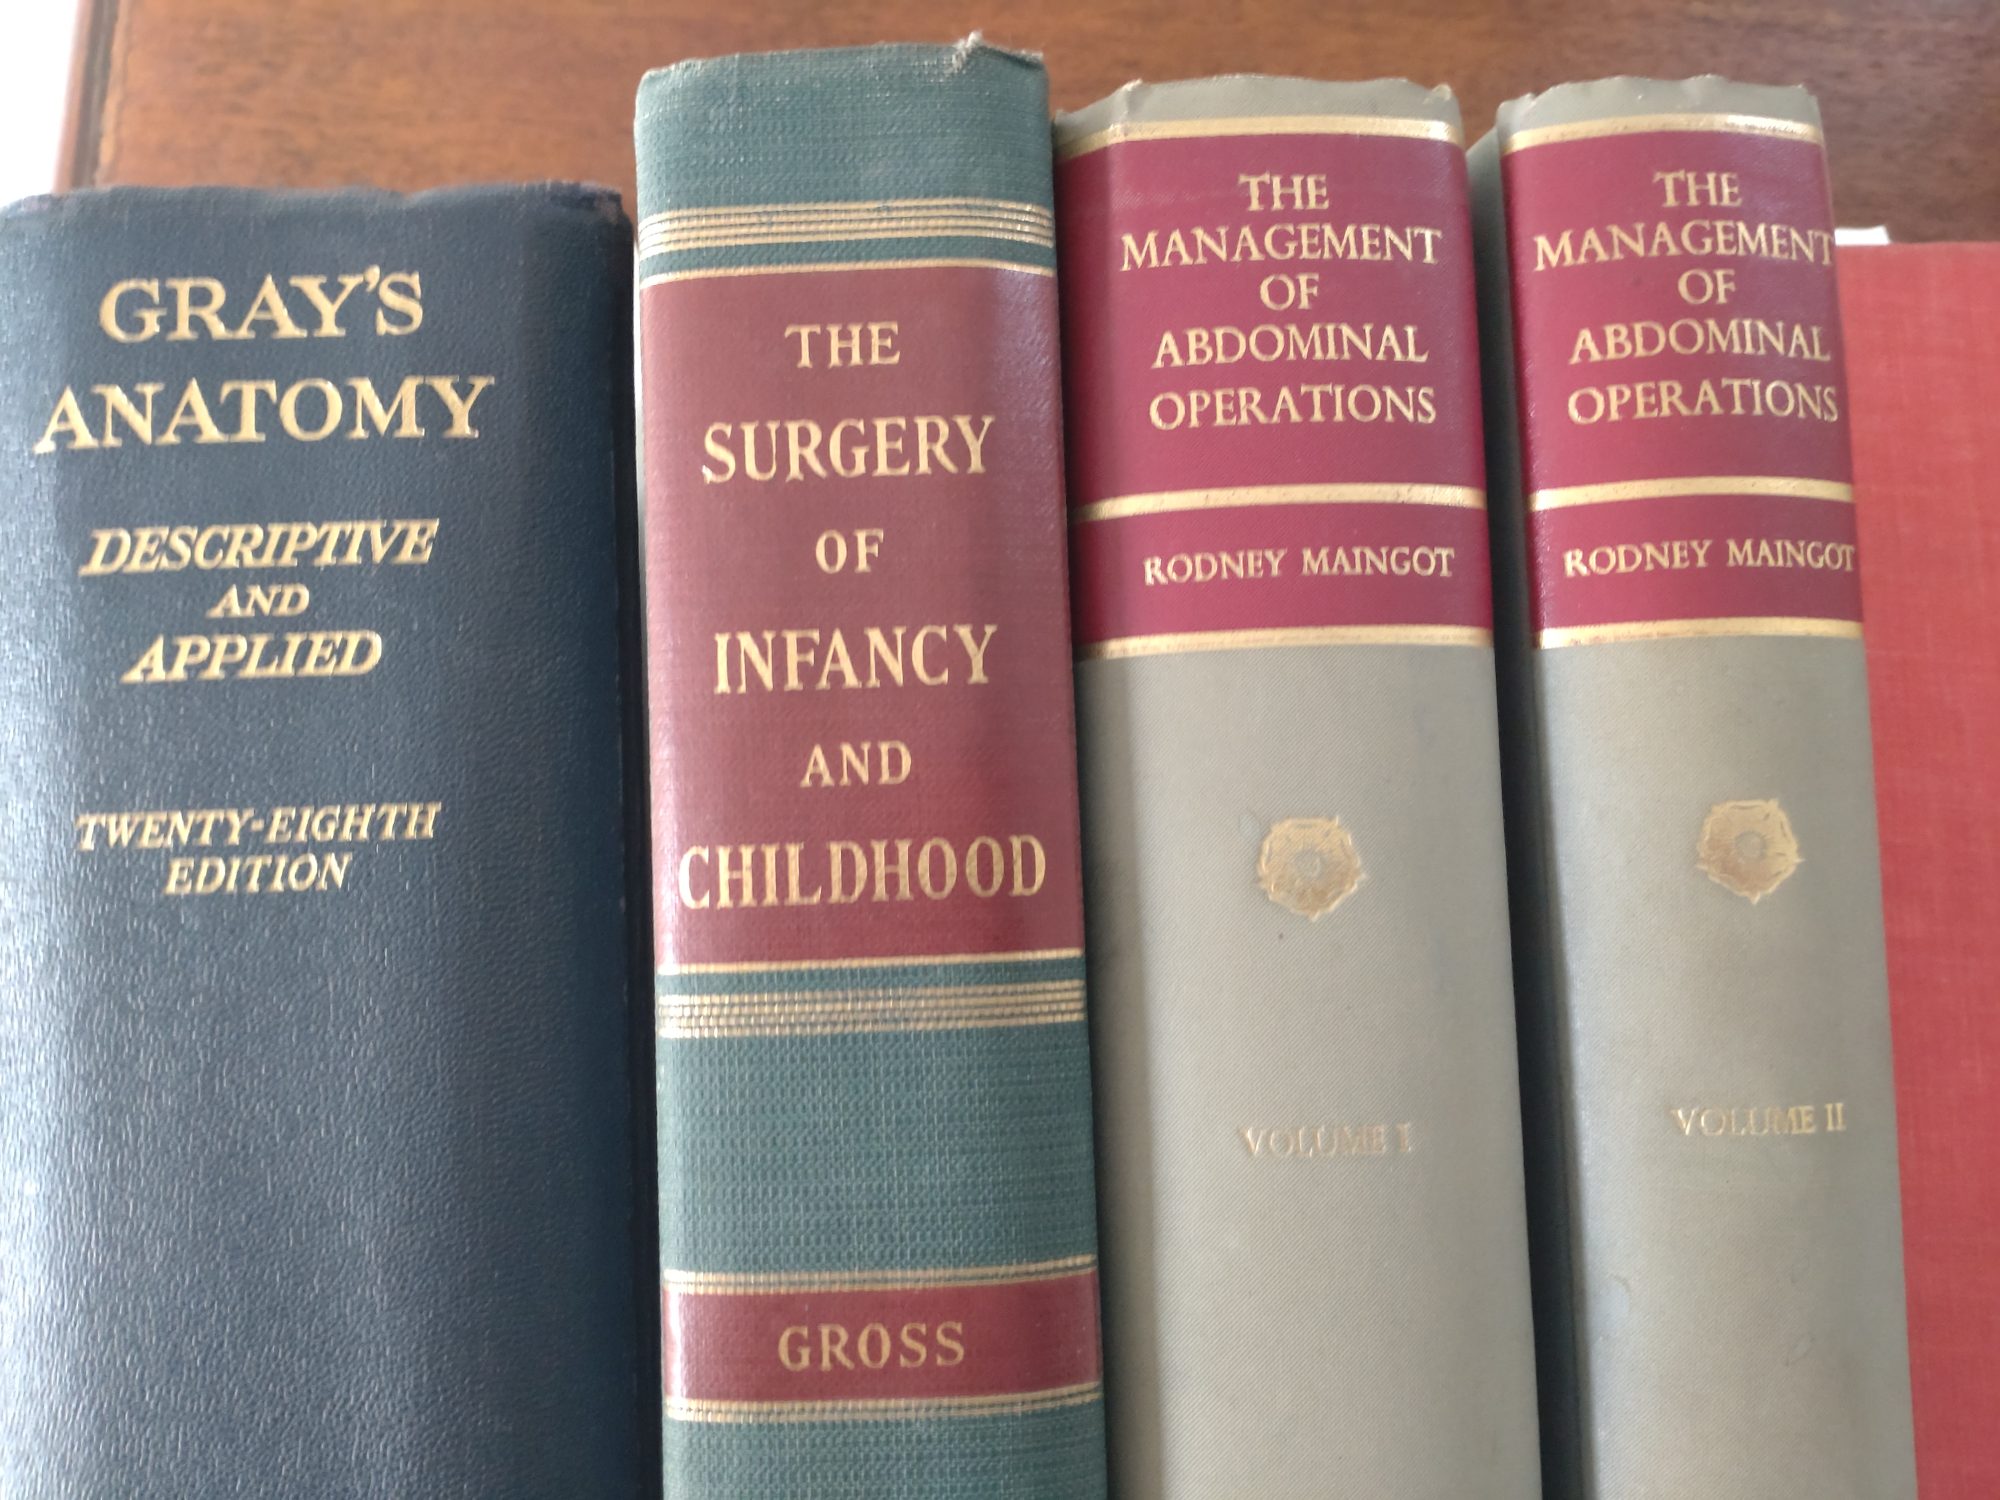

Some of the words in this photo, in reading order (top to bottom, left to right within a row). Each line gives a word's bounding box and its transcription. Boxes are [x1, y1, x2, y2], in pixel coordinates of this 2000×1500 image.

[1238, 172, 1330, 212] THE
[1653, 170, 1742, 208] THE
[1119, 223, 1442, 272] MANAGEMENT
[1533, 220, 1836, 271] MANAGEMENT
[100, 265, 423, 342] GRAY'S
[1259, 272, 1320, 311] OF
[1677, 268, 1736, 305] OF
[785, 322, 900, 369] THE
[1151, 323, 1429, 369] ABDOMINAL
[1569, 318, 1831, 365] ABDOMINAL
[34, 375, 495, 454] ANATOMY
[1149, 383, 1437, 431] OPERATIONS
[1567, 378, 1838, 424] OPERATIONS
[702, 415, 995, 484] SURGERY
[79, 519, 439, 576] DESCRIPTIVE
[815, 529, 885, 574] OF
[1143, 549, 1287, 586] RODNEY
[1301, 546, 1455, 577] MAINGOT
[1563, 539, 1713, 577] RODNEY
[1726, 538, 1855, 572] MAINGOT
[207, 583, 310, 618] AND
[122, 630, 382, 683] APPLIED
[714, 624, 997, 694] INFANCY
[801, 741, 912, 787] AND
[75, 803, 442, 851] TWENTY-EIGHTH
[164, 853, 352, 894] EDITION
[678, 834, 1046, 910] CHILDHOOD
[1239, 1124, 1387, 1157] VOLUME
[1396, 1122, 1411, 1153] I
[1670, 1105, 1816, 1136] VOLUME
[1825, 1102, 1847, 1132] II
[778, 1322, 965, 1372] GROSS
